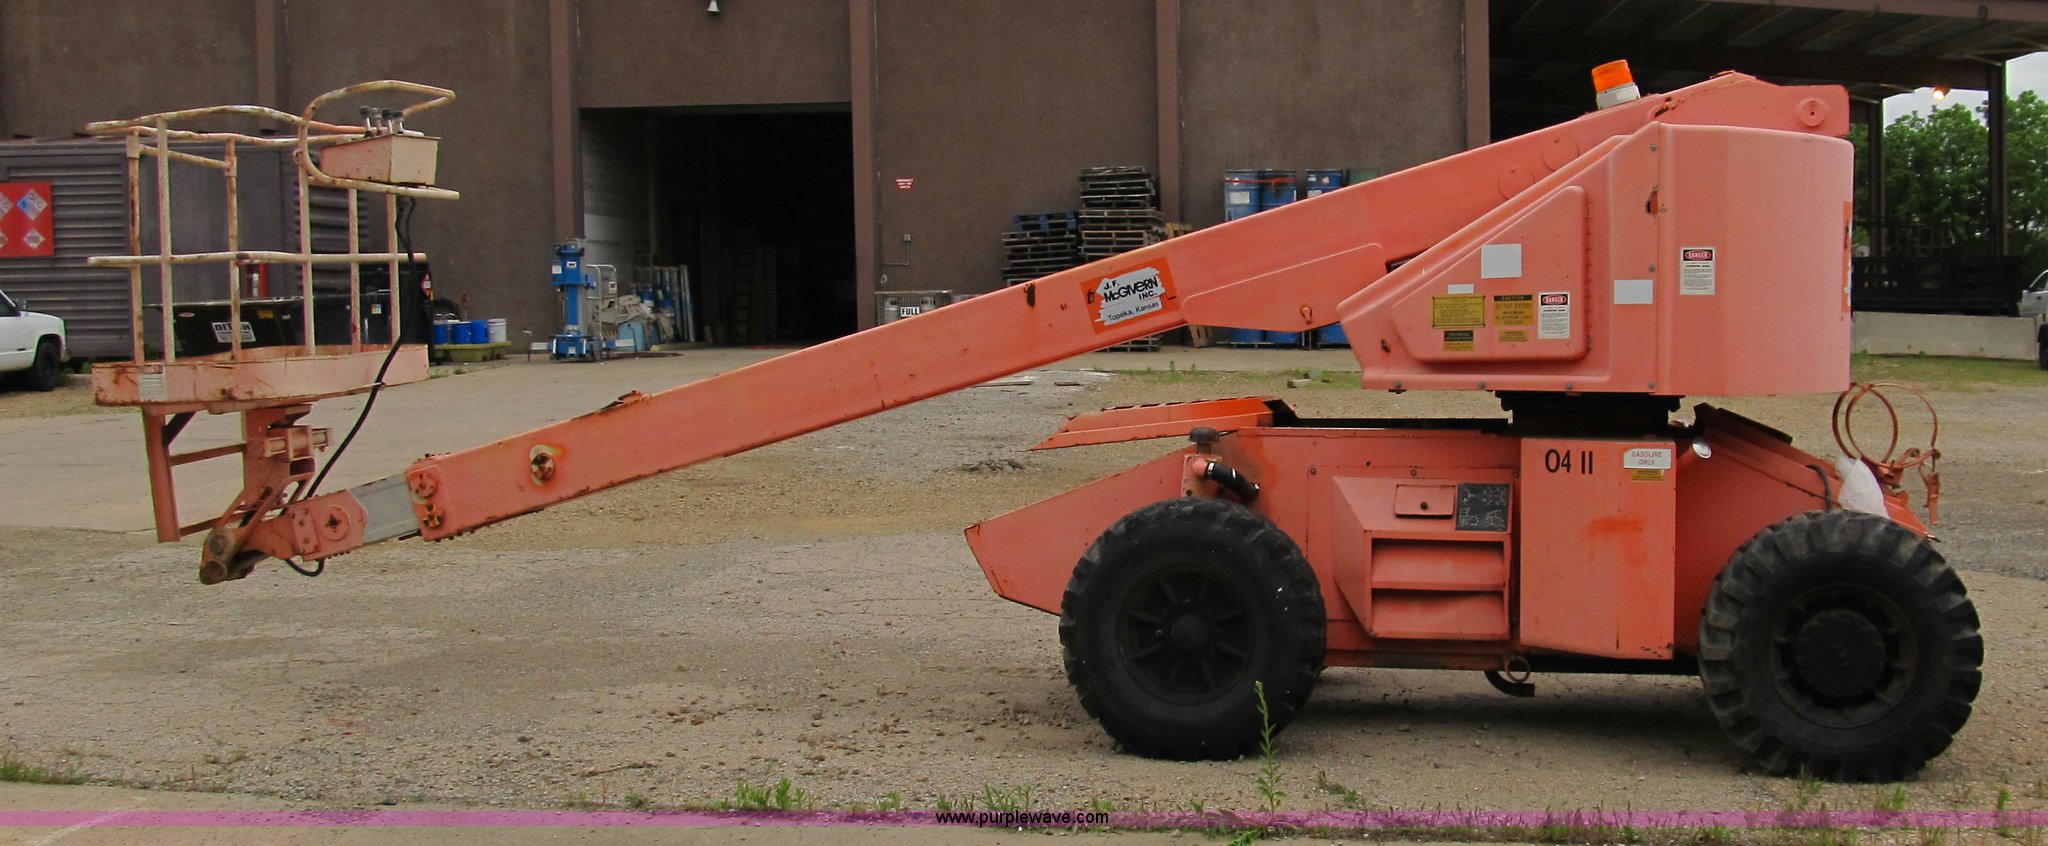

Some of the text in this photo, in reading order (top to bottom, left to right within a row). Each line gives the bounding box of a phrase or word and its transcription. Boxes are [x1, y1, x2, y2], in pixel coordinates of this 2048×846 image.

[1139, 290, 1157, 300] INC.
[1135, 302, 1159, 312] Kansas
[1545, 449, 1571, 473] 04
